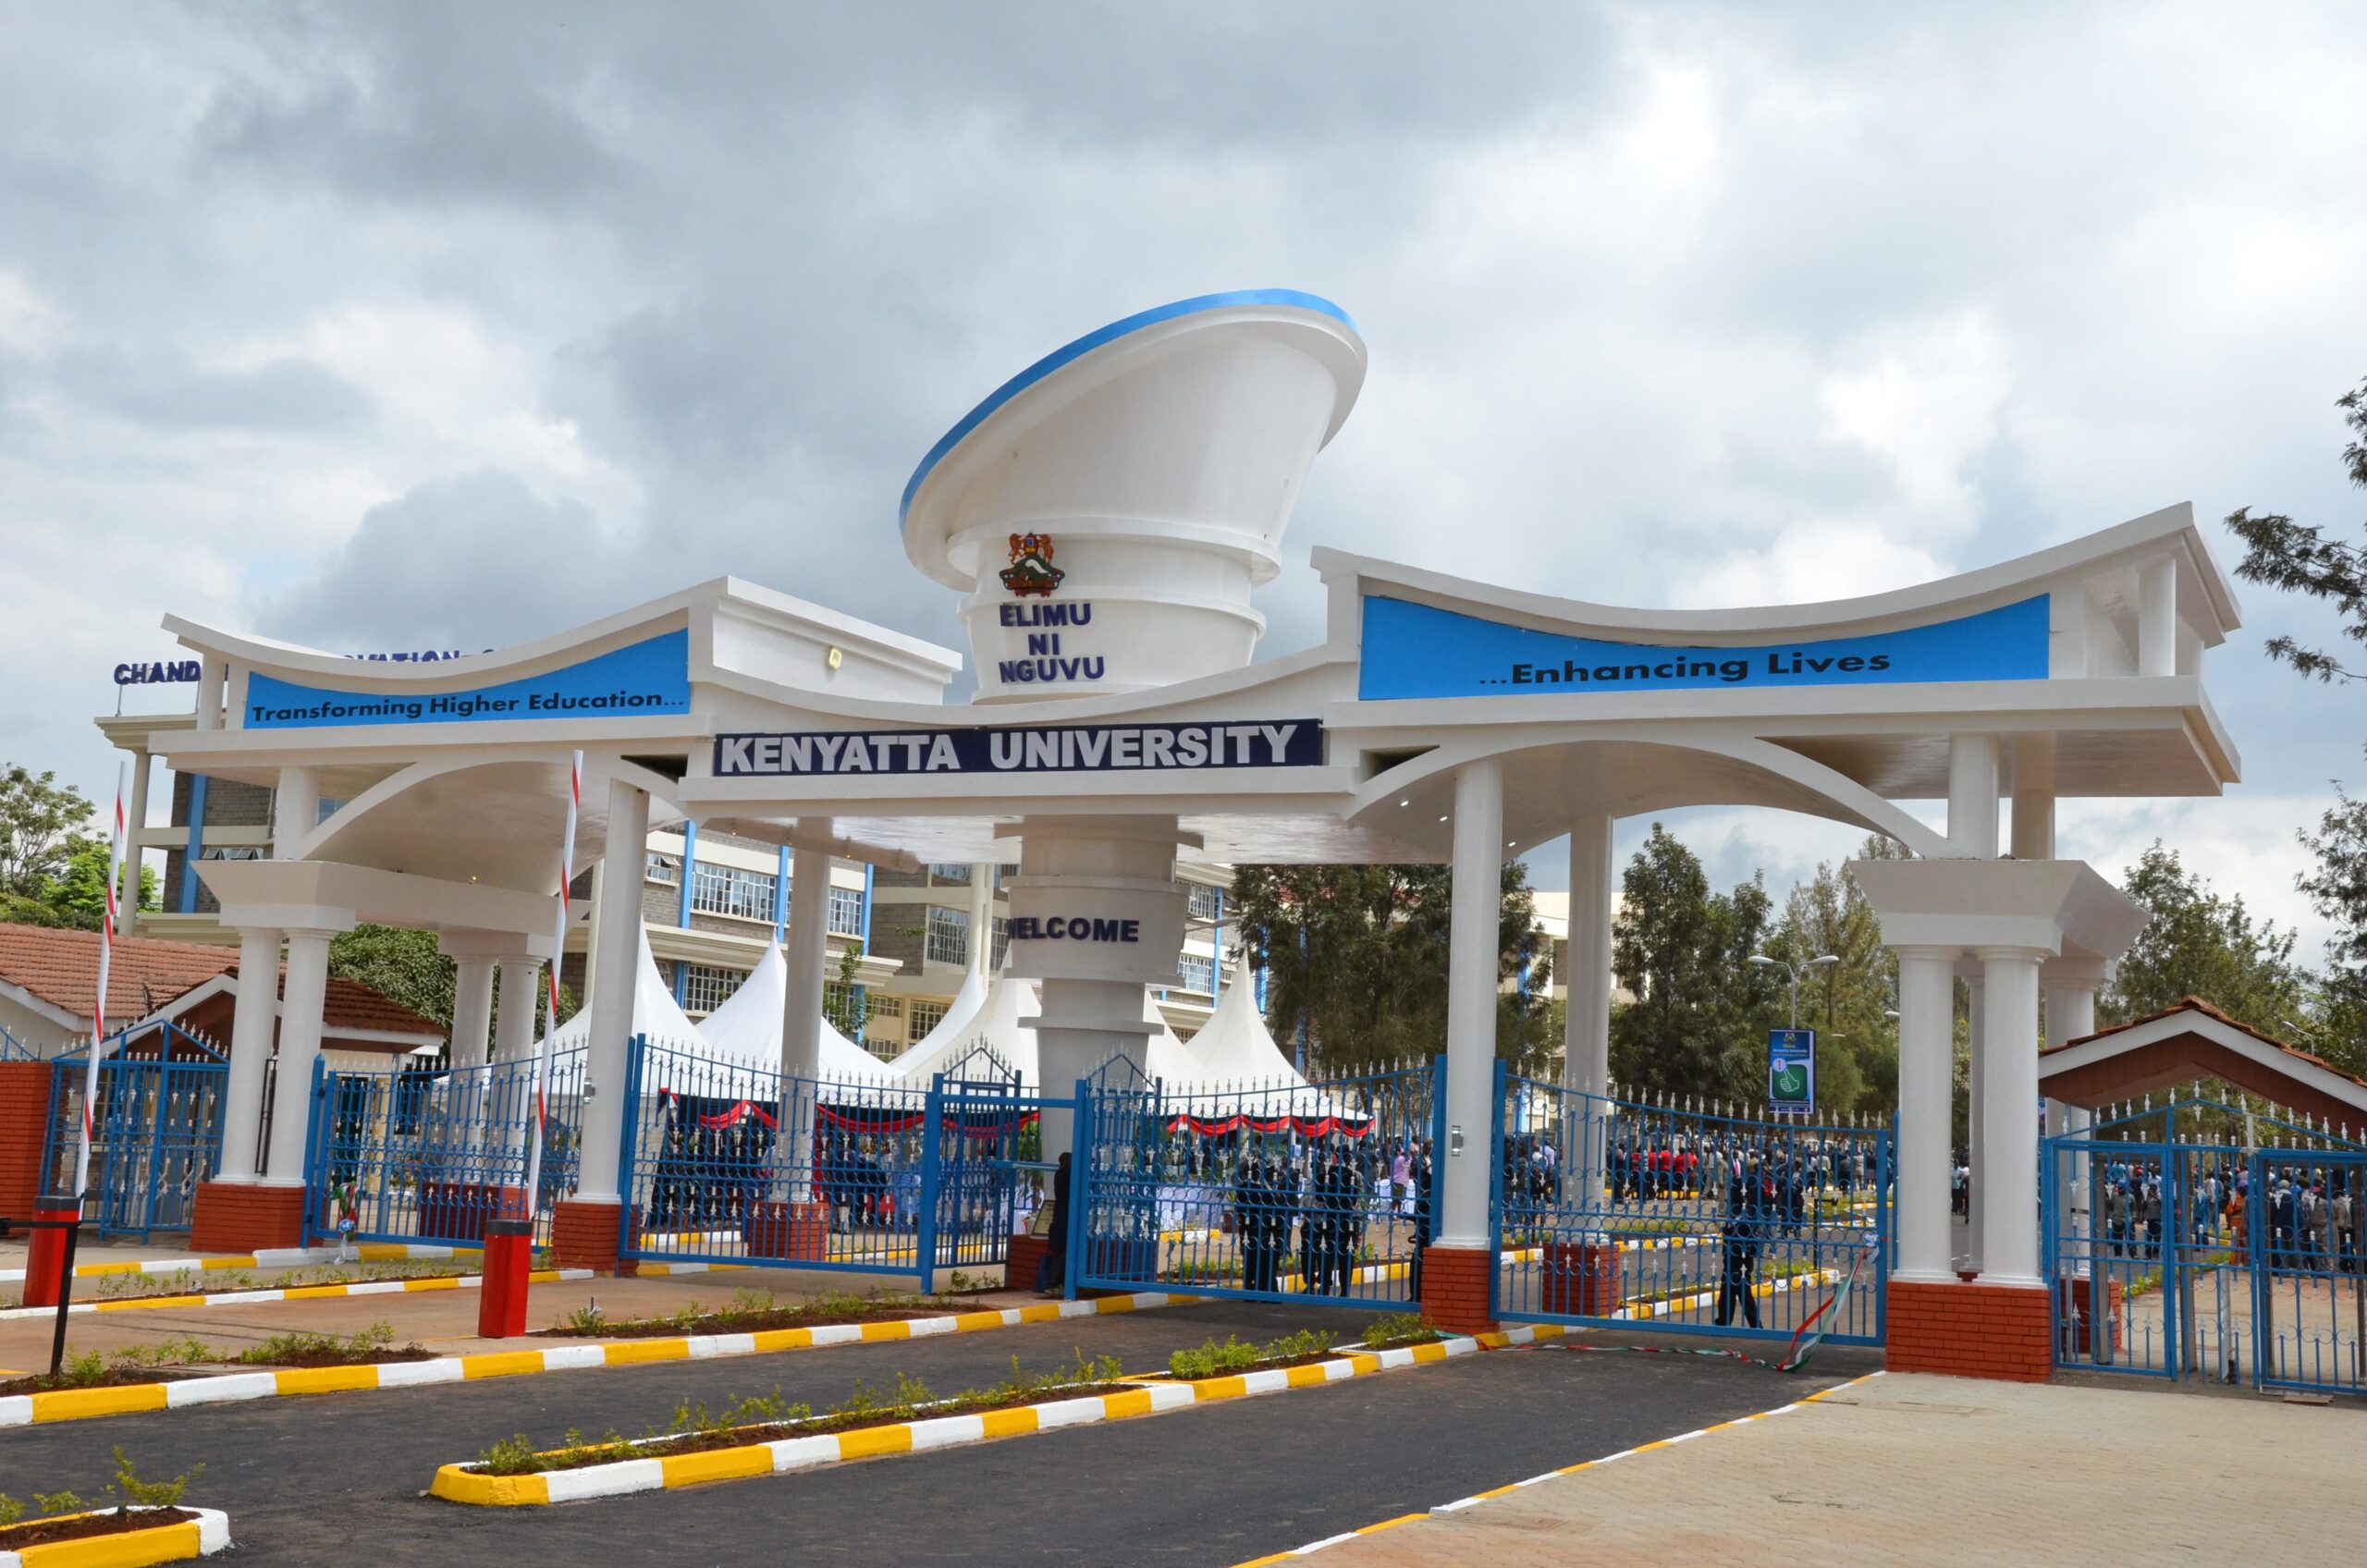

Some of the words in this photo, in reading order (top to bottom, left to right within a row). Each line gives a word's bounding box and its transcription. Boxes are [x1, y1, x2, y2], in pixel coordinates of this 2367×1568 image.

[1000, 604, 1092, 627] ELIMU
[1028, 633, 1061, 655] NI
[114, 661, 201, 685] CHAND
[999, 656, 1104, 683] NGUVU
[1768, 652, 1891, 674] Lives
[252, 699, 423, 722] Transforming
[430, 696, 520, 717] Higher
[720, 734, 961, 773] KENYATTA
[989, 724, 1296, 769] UNIVERSITY
